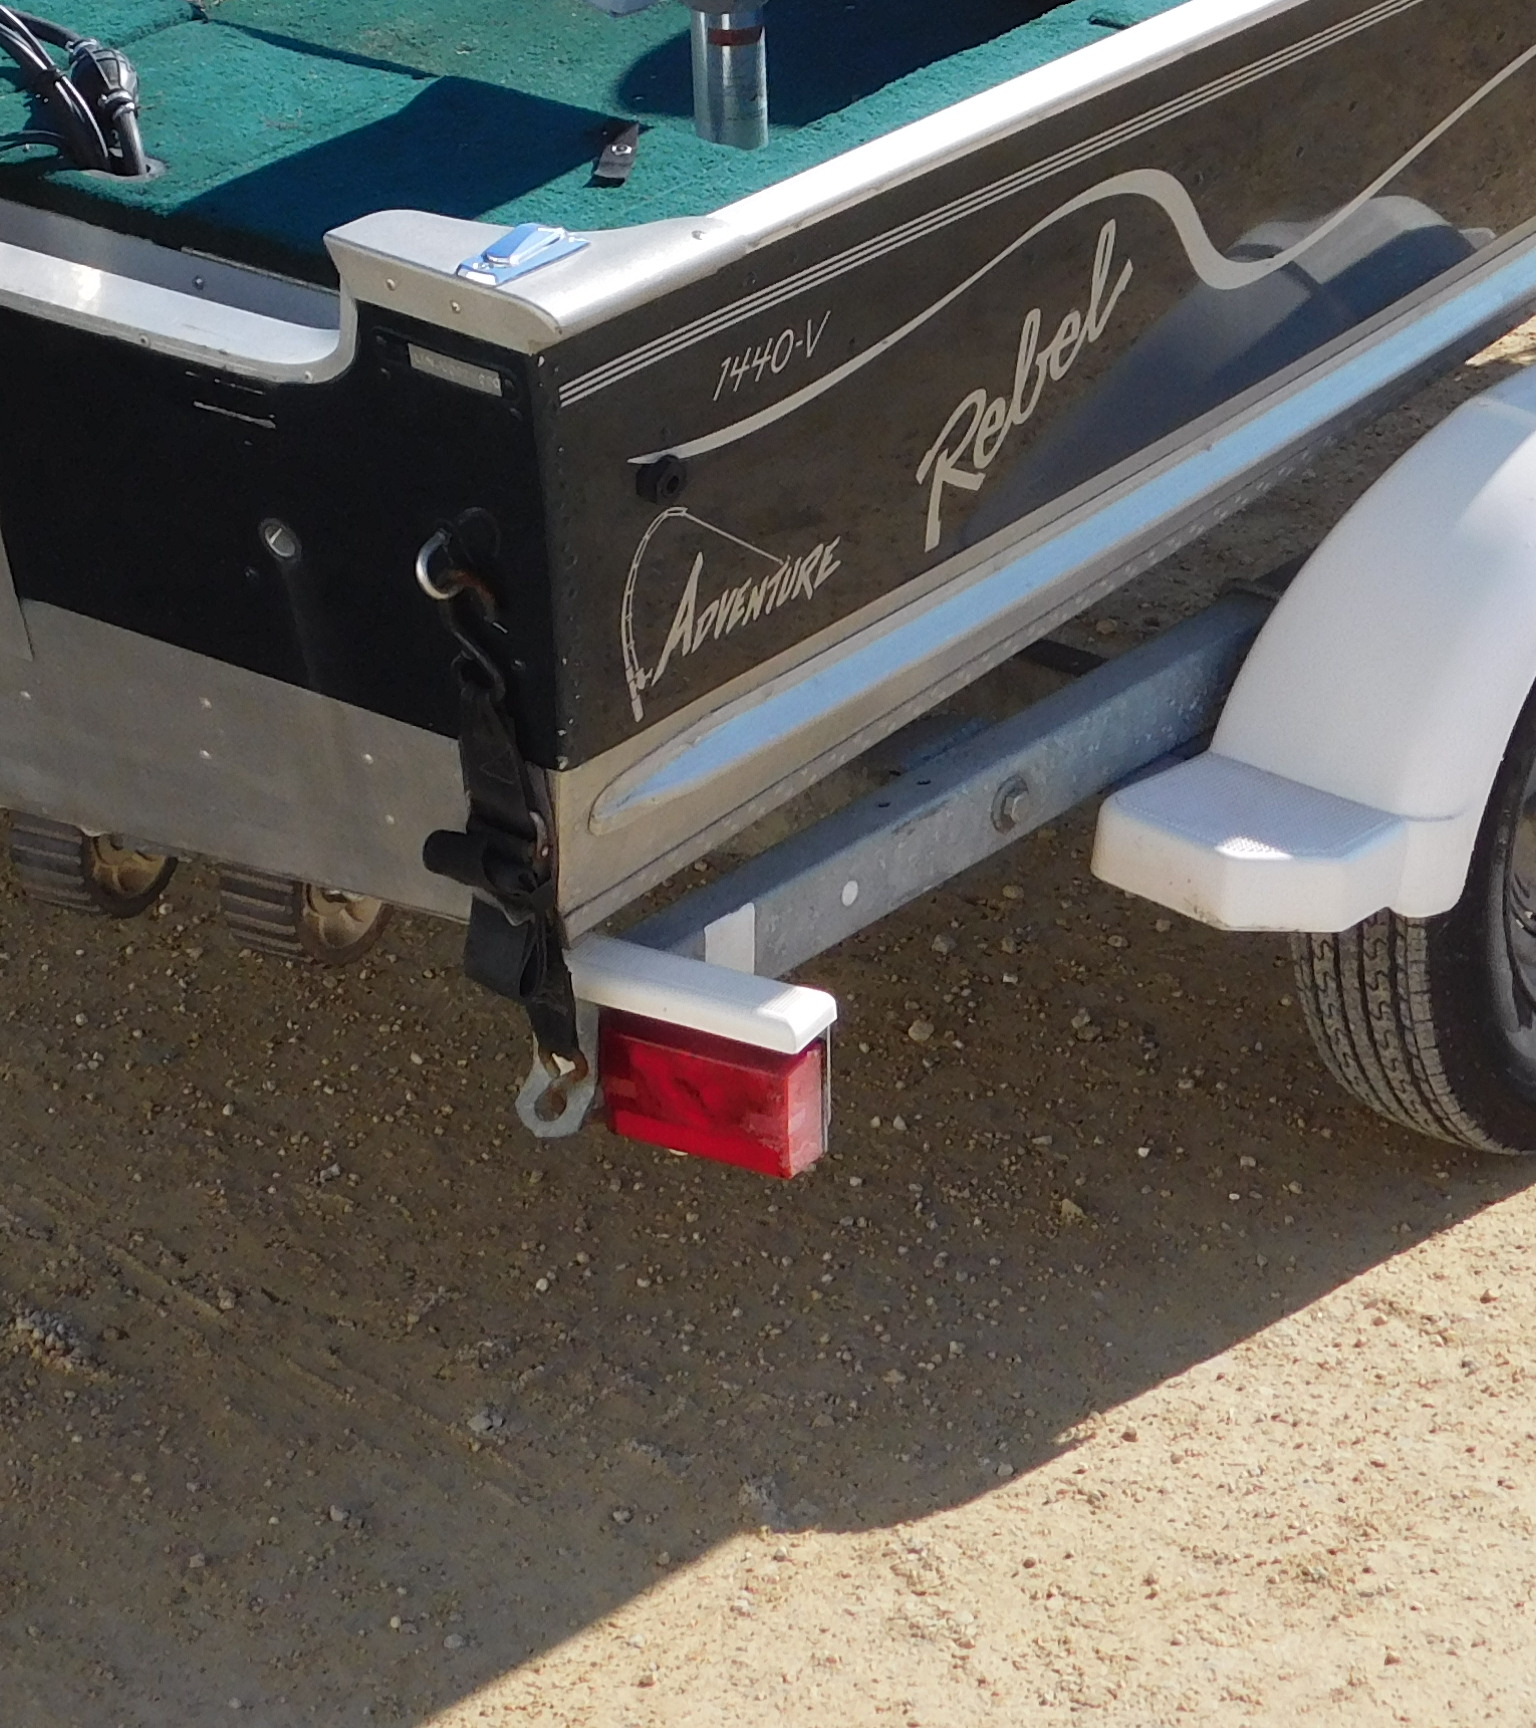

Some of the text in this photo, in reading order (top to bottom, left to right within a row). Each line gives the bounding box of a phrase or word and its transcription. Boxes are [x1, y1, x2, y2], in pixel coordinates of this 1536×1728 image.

[713, 310, 831, 402] 1440-V
[916, 219, 1133, 553] Rebel
[651, 536, 841, 687] ADVENTURE
